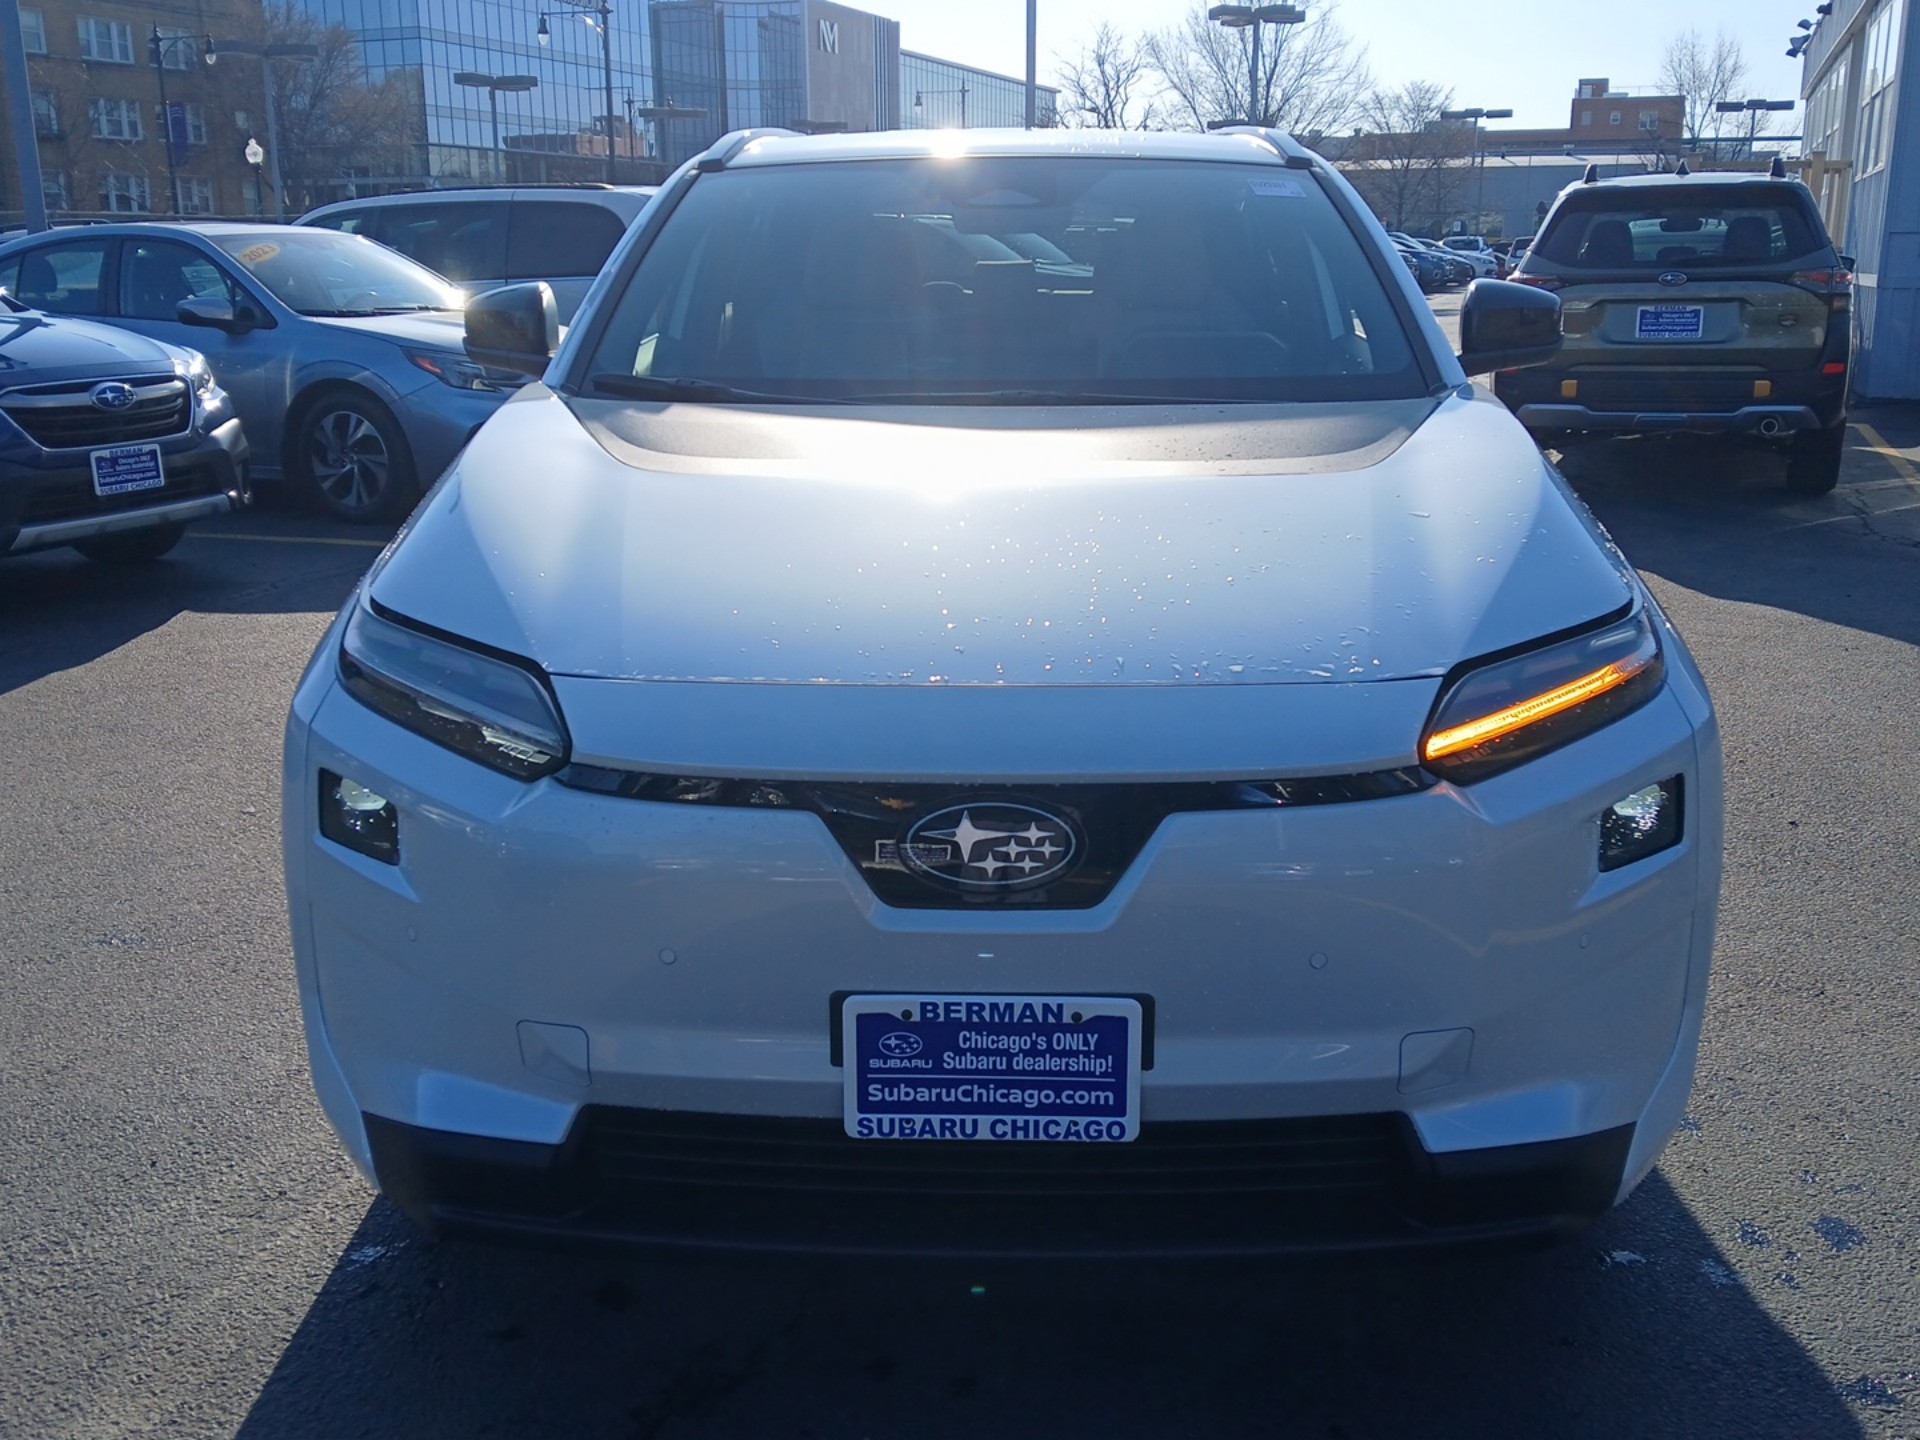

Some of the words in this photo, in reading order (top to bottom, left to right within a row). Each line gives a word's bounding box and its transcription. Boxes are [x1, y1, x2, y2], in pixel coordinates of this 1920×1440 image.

[919, 1001, 1064, 1024] BERMAN
[958, 1031, 1048, 1053] Chicago's
[1053, 1032, 1099, 1051] ONLY
[869, 1058, 932, 1069] SUBARU
[943, 1052, 1008, 1071] Subaru
[1012, 1054, 1113, 1076] dealership!
[867, 1084, 1115, 1109] SubaruChicago.com
[857, 1117, 979, 1139] SUBARU
[989, 1118, 1126, 1141] CHICAGO
